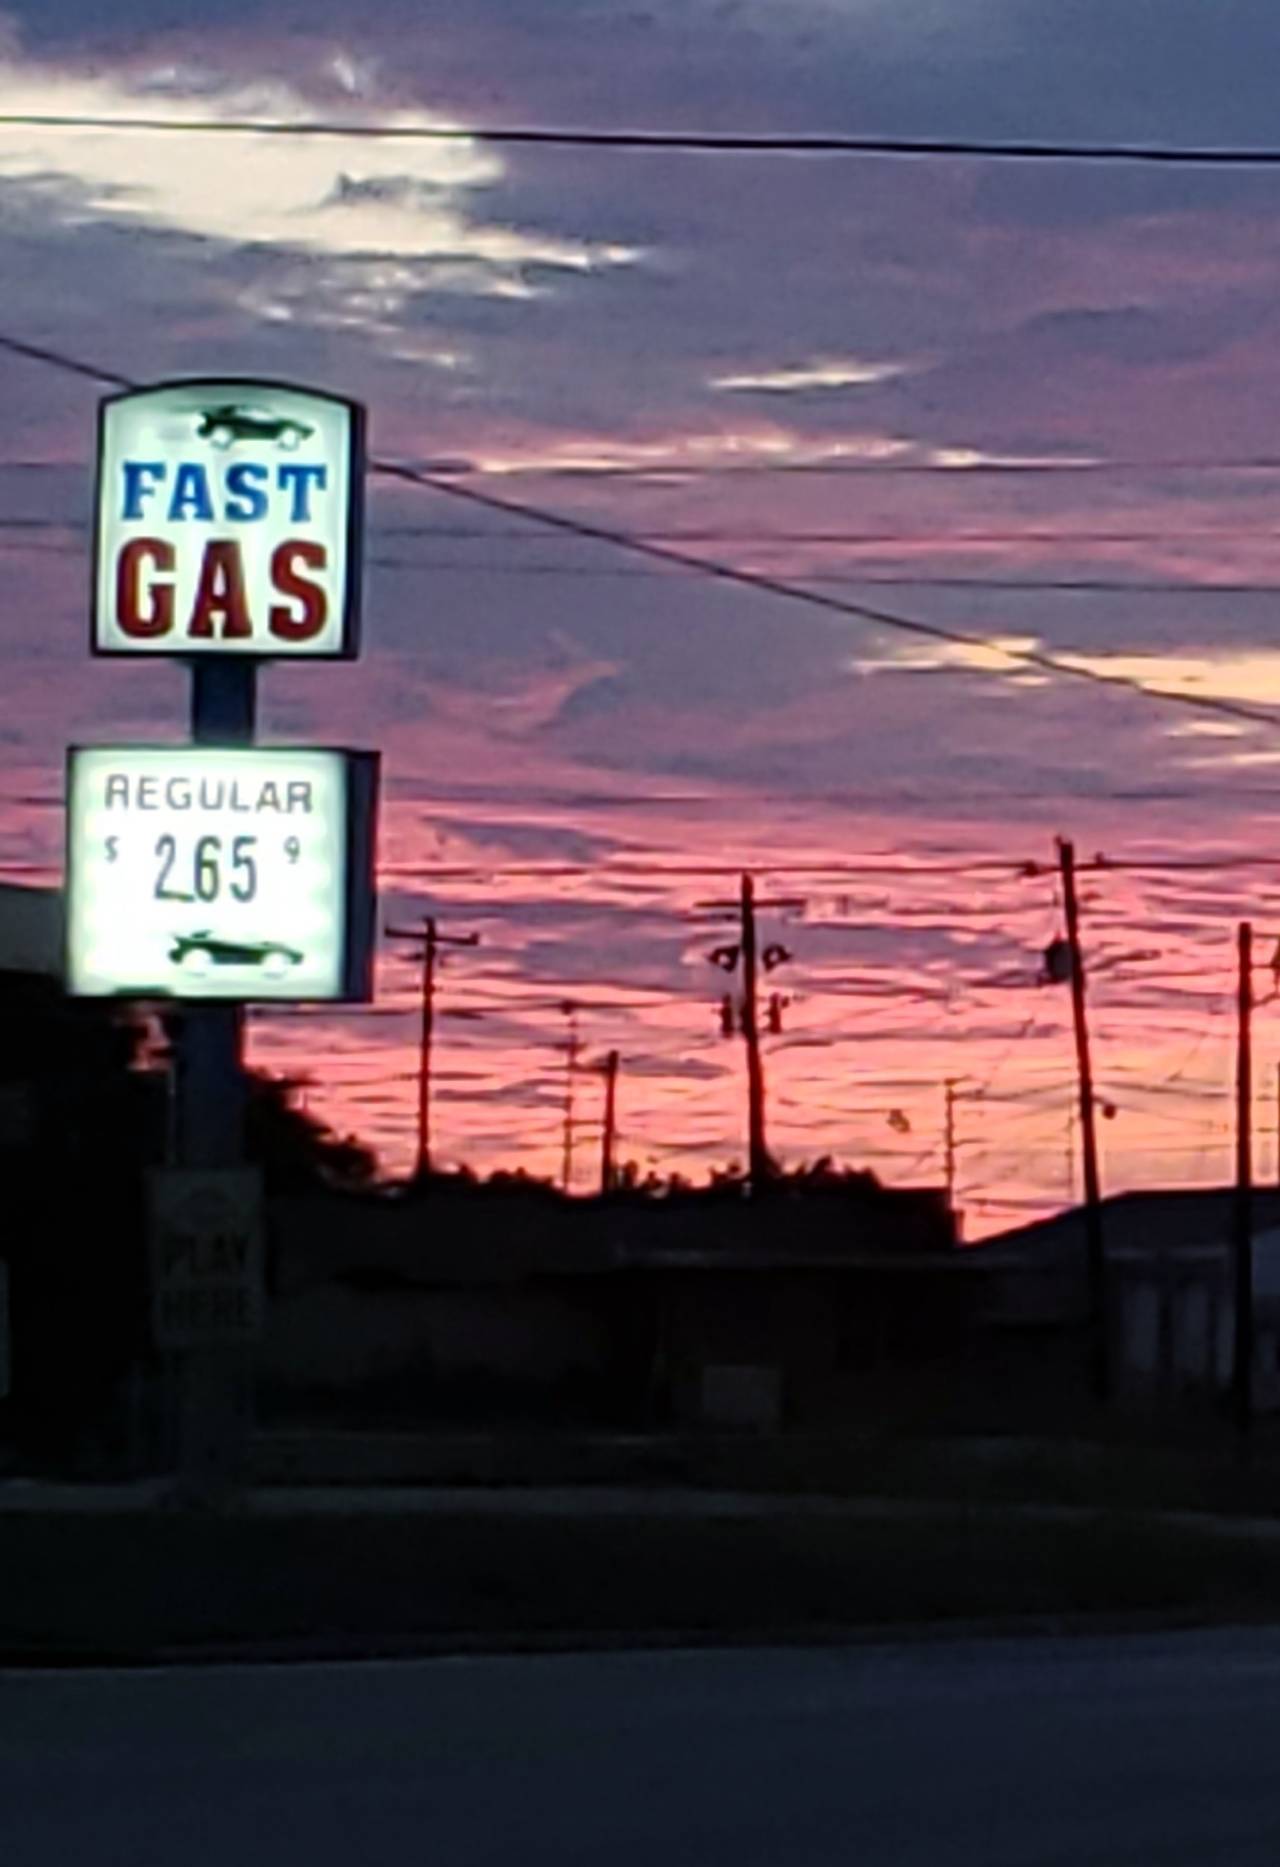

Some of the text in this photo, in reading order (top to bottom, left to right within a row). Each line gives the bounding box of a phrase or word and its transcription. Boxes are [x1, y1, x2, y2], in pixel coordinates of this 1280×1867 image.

[121, 461, 327, 523] FAST
[115, 536, 328, 642] GAS
[104, 773, 314, 814] REGULAR
[283, 836, 301, 864] 9
[162, 1232, 251, 1276] PLAY
[161, 1288, 254, 1329] HERE
